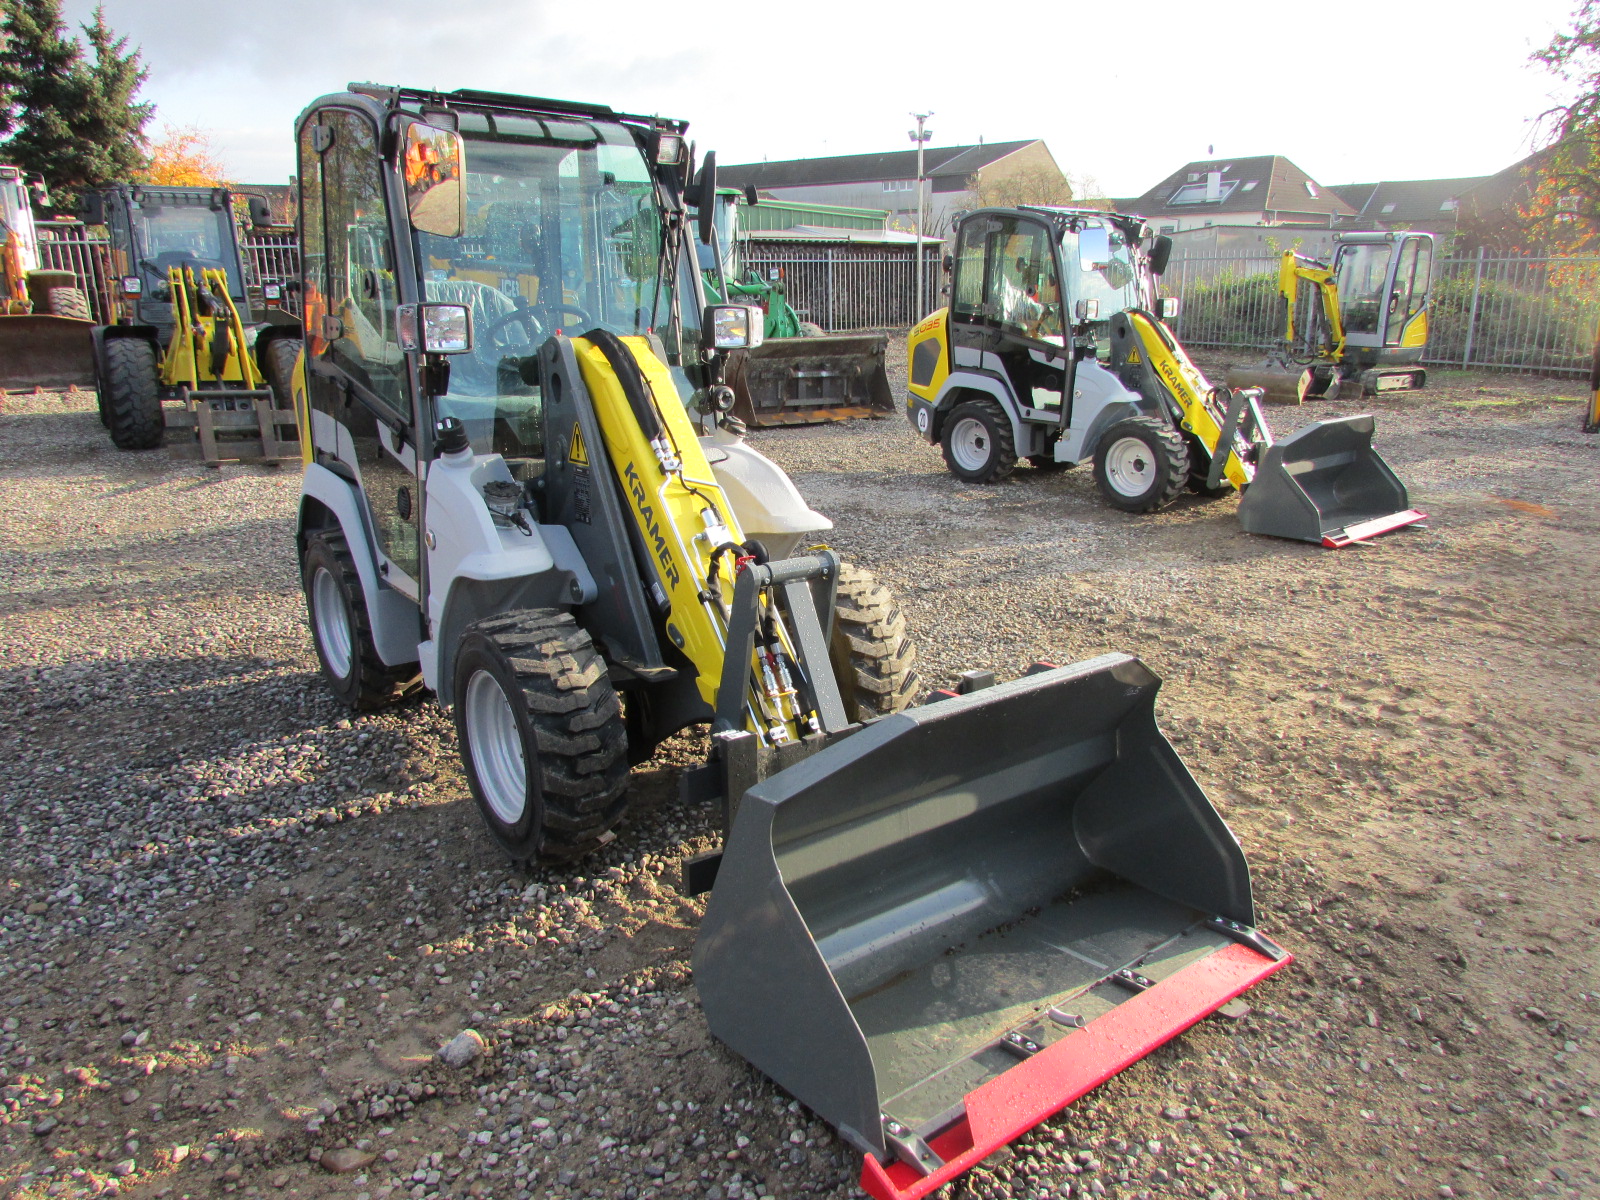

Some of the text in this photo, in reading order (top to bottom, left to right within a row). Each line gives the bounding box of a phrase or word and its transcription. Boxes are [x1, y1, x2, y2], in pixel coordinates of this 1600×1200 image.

[499, 279, 520, 298] JCB
[914, 318, 941, 338] 5035
[1159, 360, 1193, 408] KRAMER
[920, 412, 926, 428] 20
[624, 461, 680, 592] KRAMER
